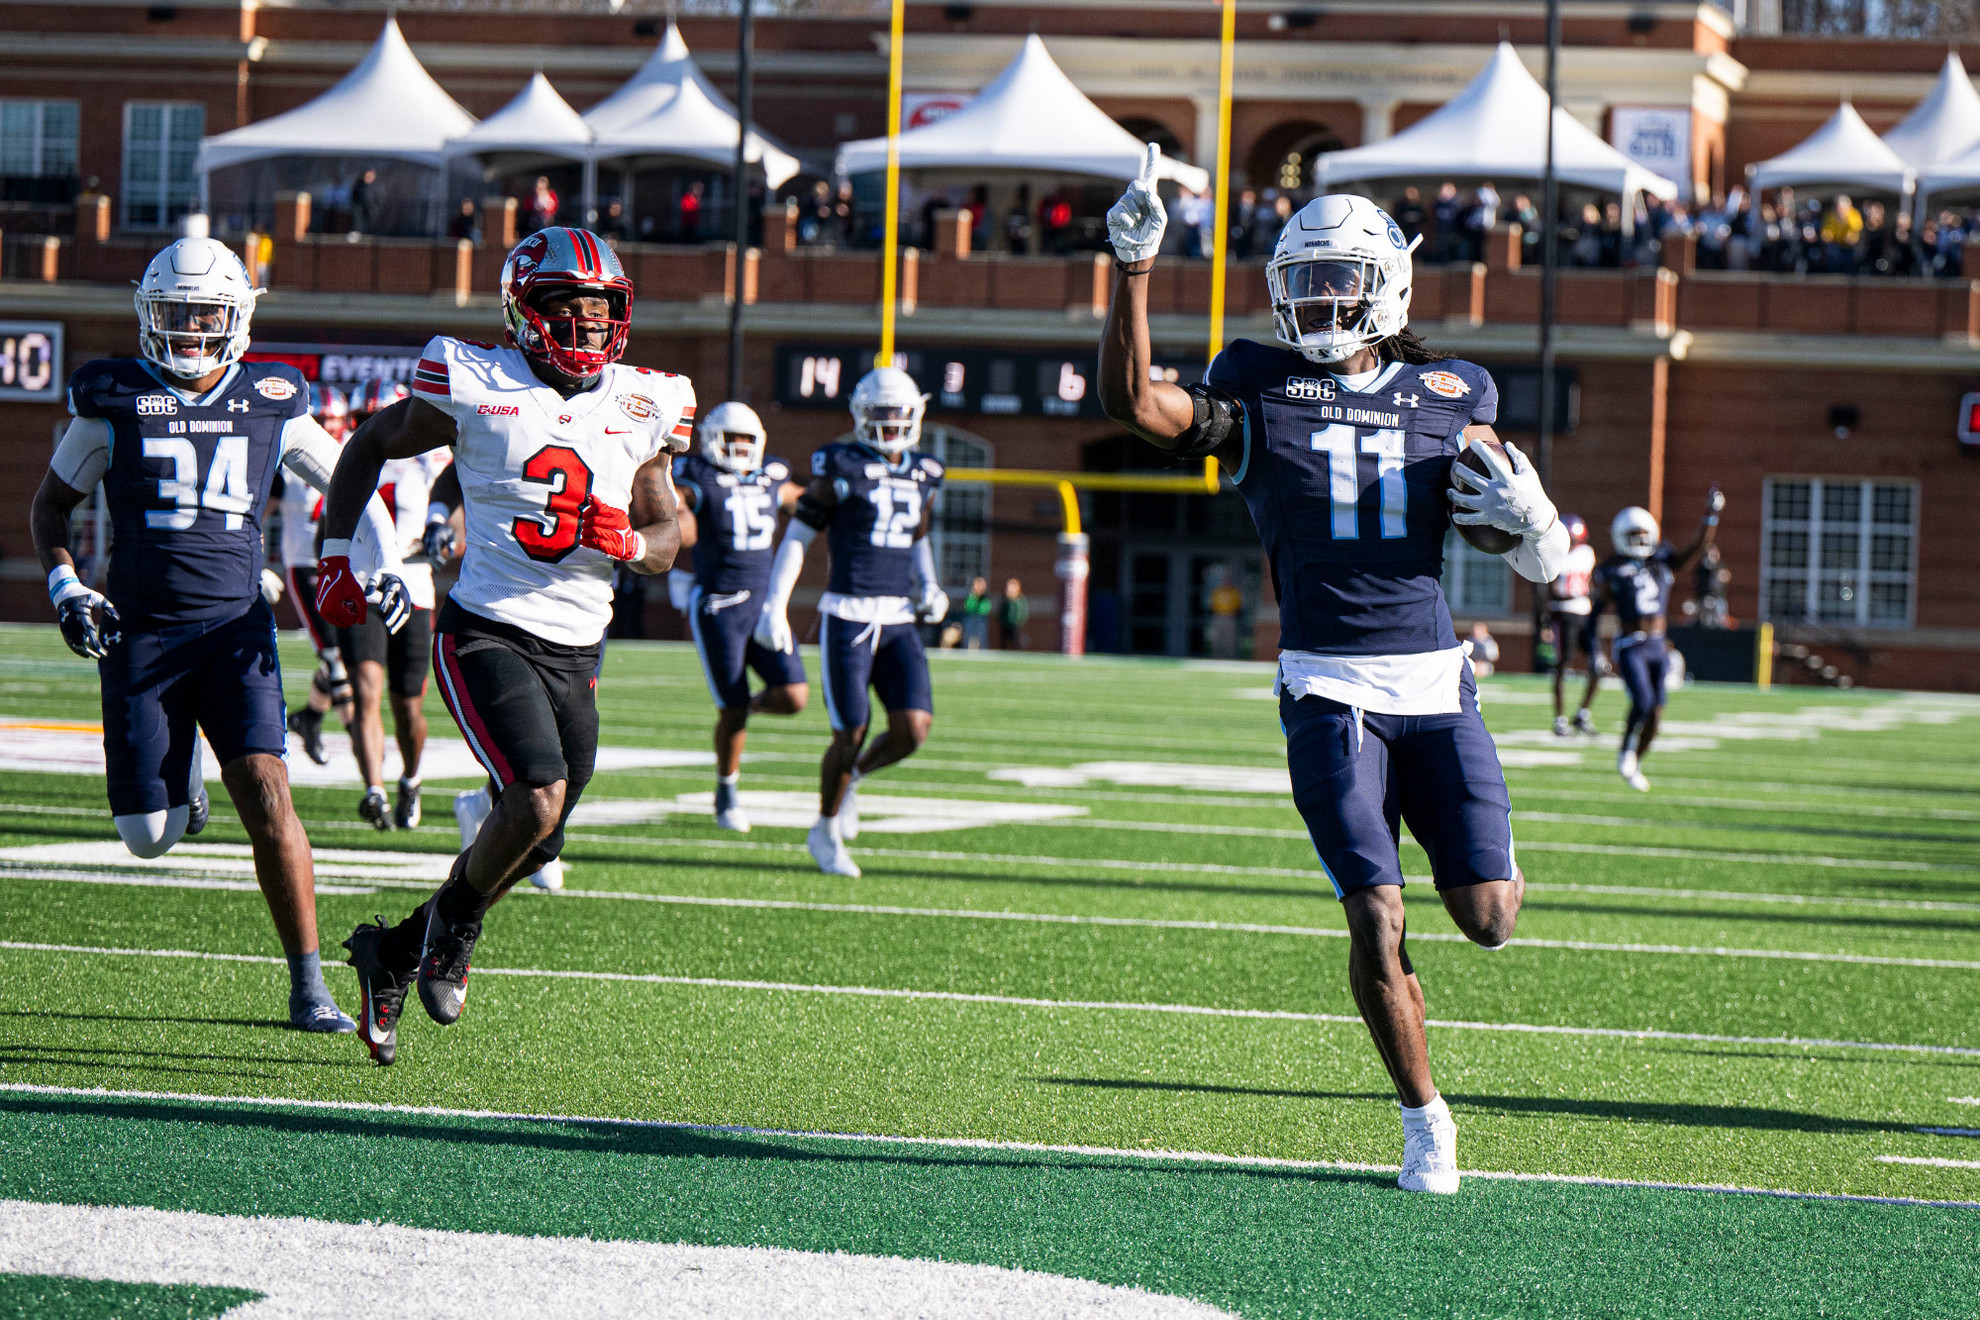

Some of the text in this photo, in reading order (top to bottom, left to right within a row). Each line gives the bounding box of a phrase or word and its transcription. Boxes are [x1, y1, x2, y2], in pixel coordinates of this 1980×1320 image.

[1304, 240, 1330, 248] MONARCHS
[800, 356, 842, 399] 14
[1058, 362, 1086, 401] 6
[1286, 376, 1336, 401] SBC
[136, 395, 178, 416] SBC
[1321, 405, 1399, 427] OLD DOMINION
[168, 420, 233, 433] OLD DOMINION
[142, 436, 254, 531] 34
[1311, 423, 1407, 540] 11
[511, 444, 595, 564] 3
[725, 492, 776, 550] 15
[869, 487, 922, 548] 12
